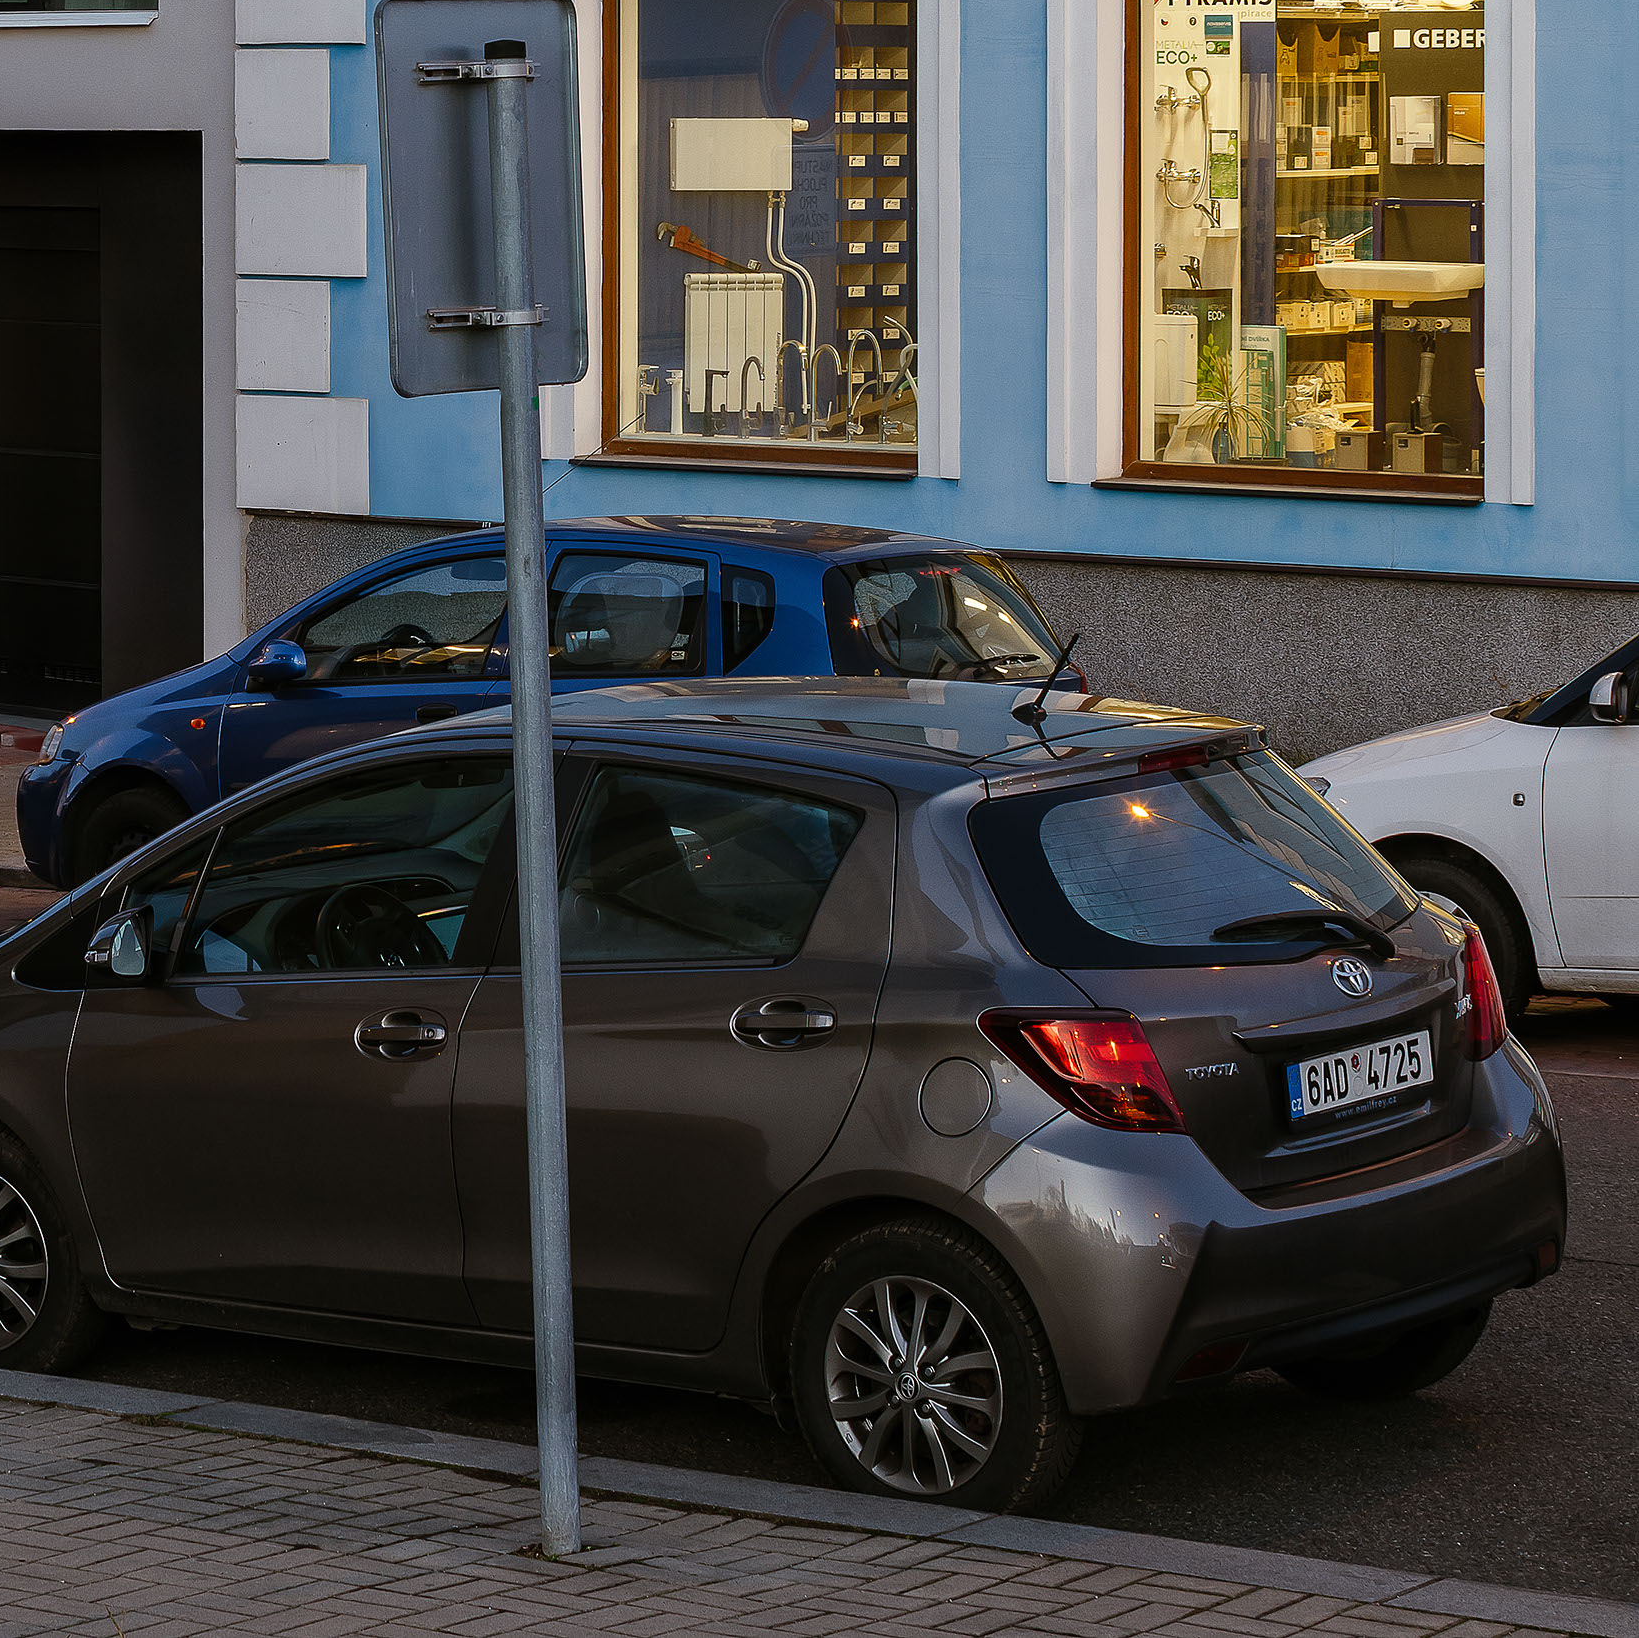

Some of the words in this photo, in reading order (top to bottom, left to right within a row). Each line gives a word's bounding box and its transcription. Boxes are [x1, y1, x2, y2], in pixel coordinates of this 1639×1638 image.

[1413, 28, 1485, 49] GEBER
[1156, 50, 1198, 65] ECO+
[1185, 1062, 1240, 1081] TOYOTA
[1307, 1058, 1349, 1107] 6AD
[1367, 1038, 1422, 1090] 4725
[1291, 1098, 1303, 1112] CZ
[1334, 1095, 1397, 1119] www.emilfrey.cz
